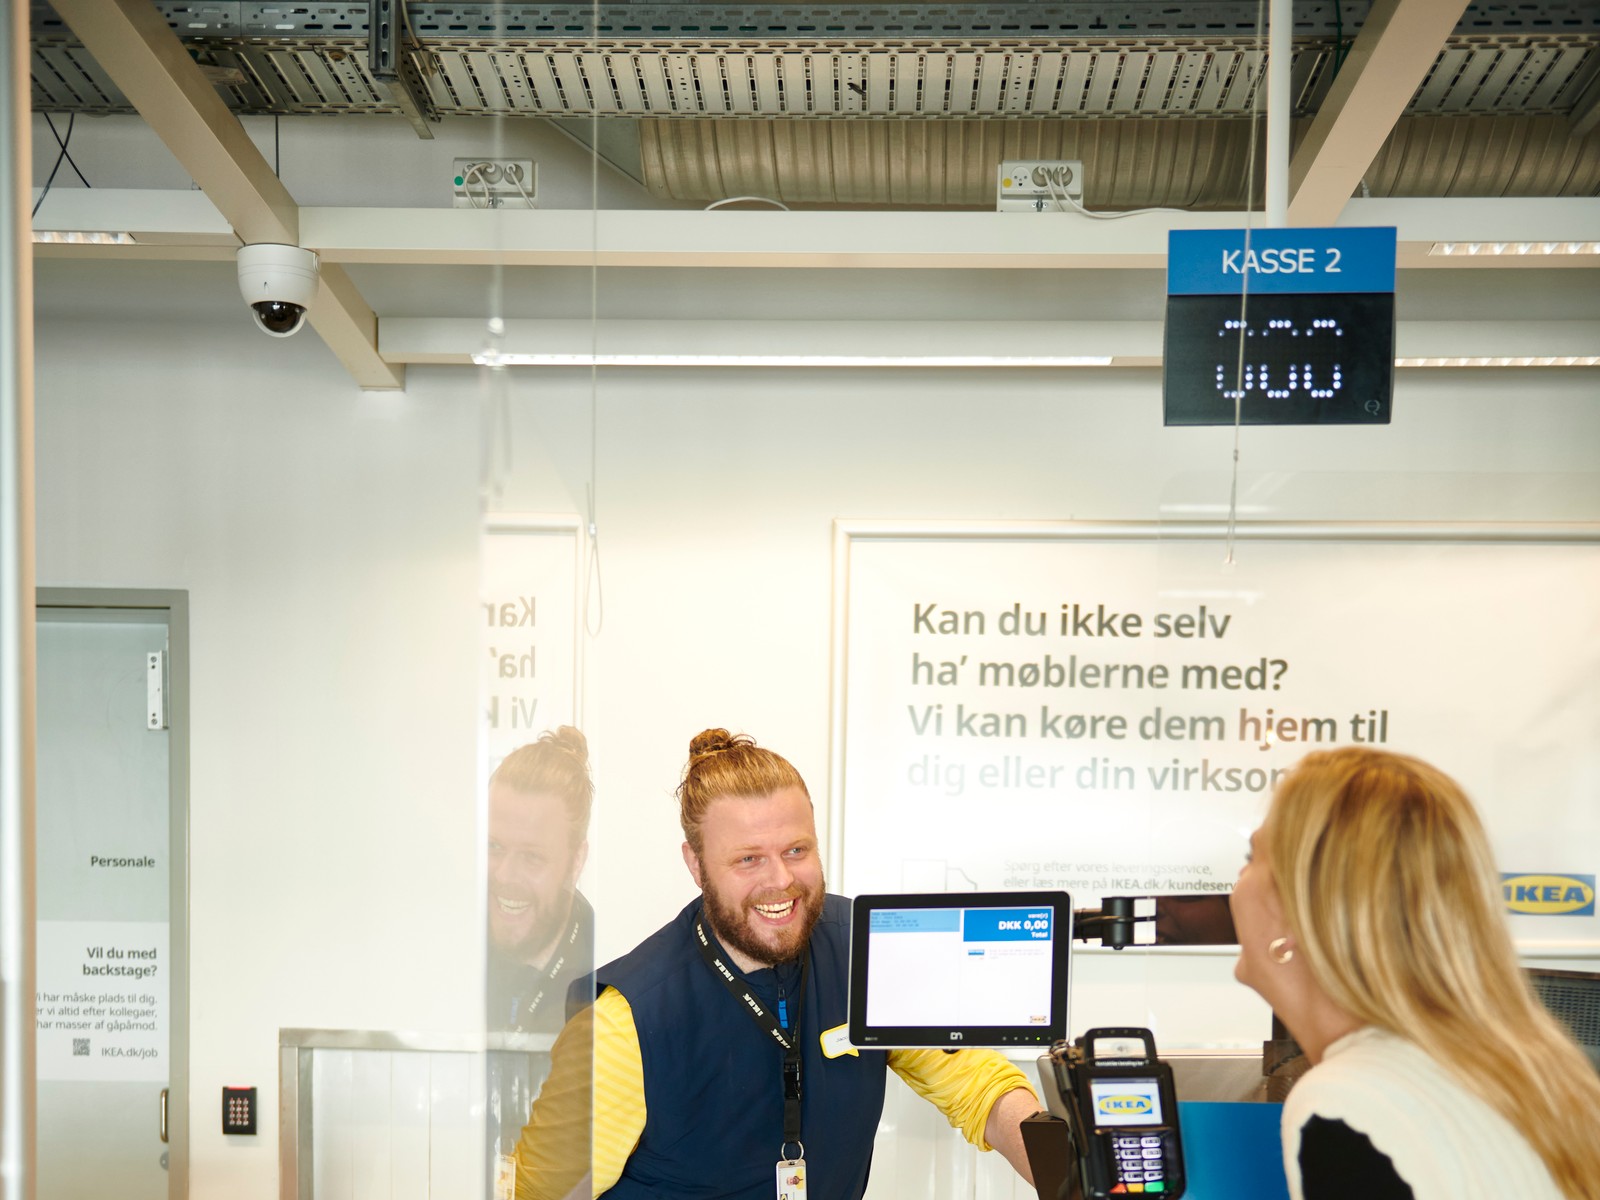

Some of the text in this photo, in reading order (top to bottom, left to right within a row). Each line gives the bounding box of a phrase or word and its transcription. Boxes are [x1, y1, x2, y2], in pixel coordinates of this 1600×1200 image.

[1222, 248, 1342, 274] KASSE 2
[913, 602, 1232, 639] Kan du ikke selv
[978, 654, 1169, 689] møblerne
[1181, 657, 1288, 691] med?
[907, 704, 1388, 751] Vi kan køre dem hjem til
[906, 754, 966, 797] dig
[978, 755, 1065, 789] eller
[1075, 757, 1136, 791] din
[91, 855, 156, 868] Personale
[1043, 861, 1072, 872] efter
[1075, 863, 1109, 872] vores
[1003, 876, 1028, 888] eller
[1057, 879, 1089, 889] mere
[1092, 877, 1107, 891] på
[1502, 885, 1586, 903] IKEA
[998, 919, 1049, 931] DKK 0,00
[86, 946, 157, 959] Vil du med
[82, 963, 158, 980] backstage?
[713, 958, 735, 982] IKEA
[43, 992, 60, 1002] har
[62, 992, 96, 1003] måske
[98, 993, 125, 1005] plads
[127, 993, 137, 1003] til
[138, 993, 158, 1006] dig.
[742, 992, 764, 1017] IKEA
[46, 1006, 55, 1015] vi
[58, 1006, 80, 1016] altid
[82, 1006, 107, 1016] efter
[109, 1006, 158, 1019] kollegaer,
[55, 1021, 92, 1030] masser
[94, 1019, 104, 1030] af
[106, 1020, 158, 1032] gåpåmod.
[101, 1047, 158, 1059] IKEA.dk/job
[1105, 1100, 1146, 1109] IKEA
